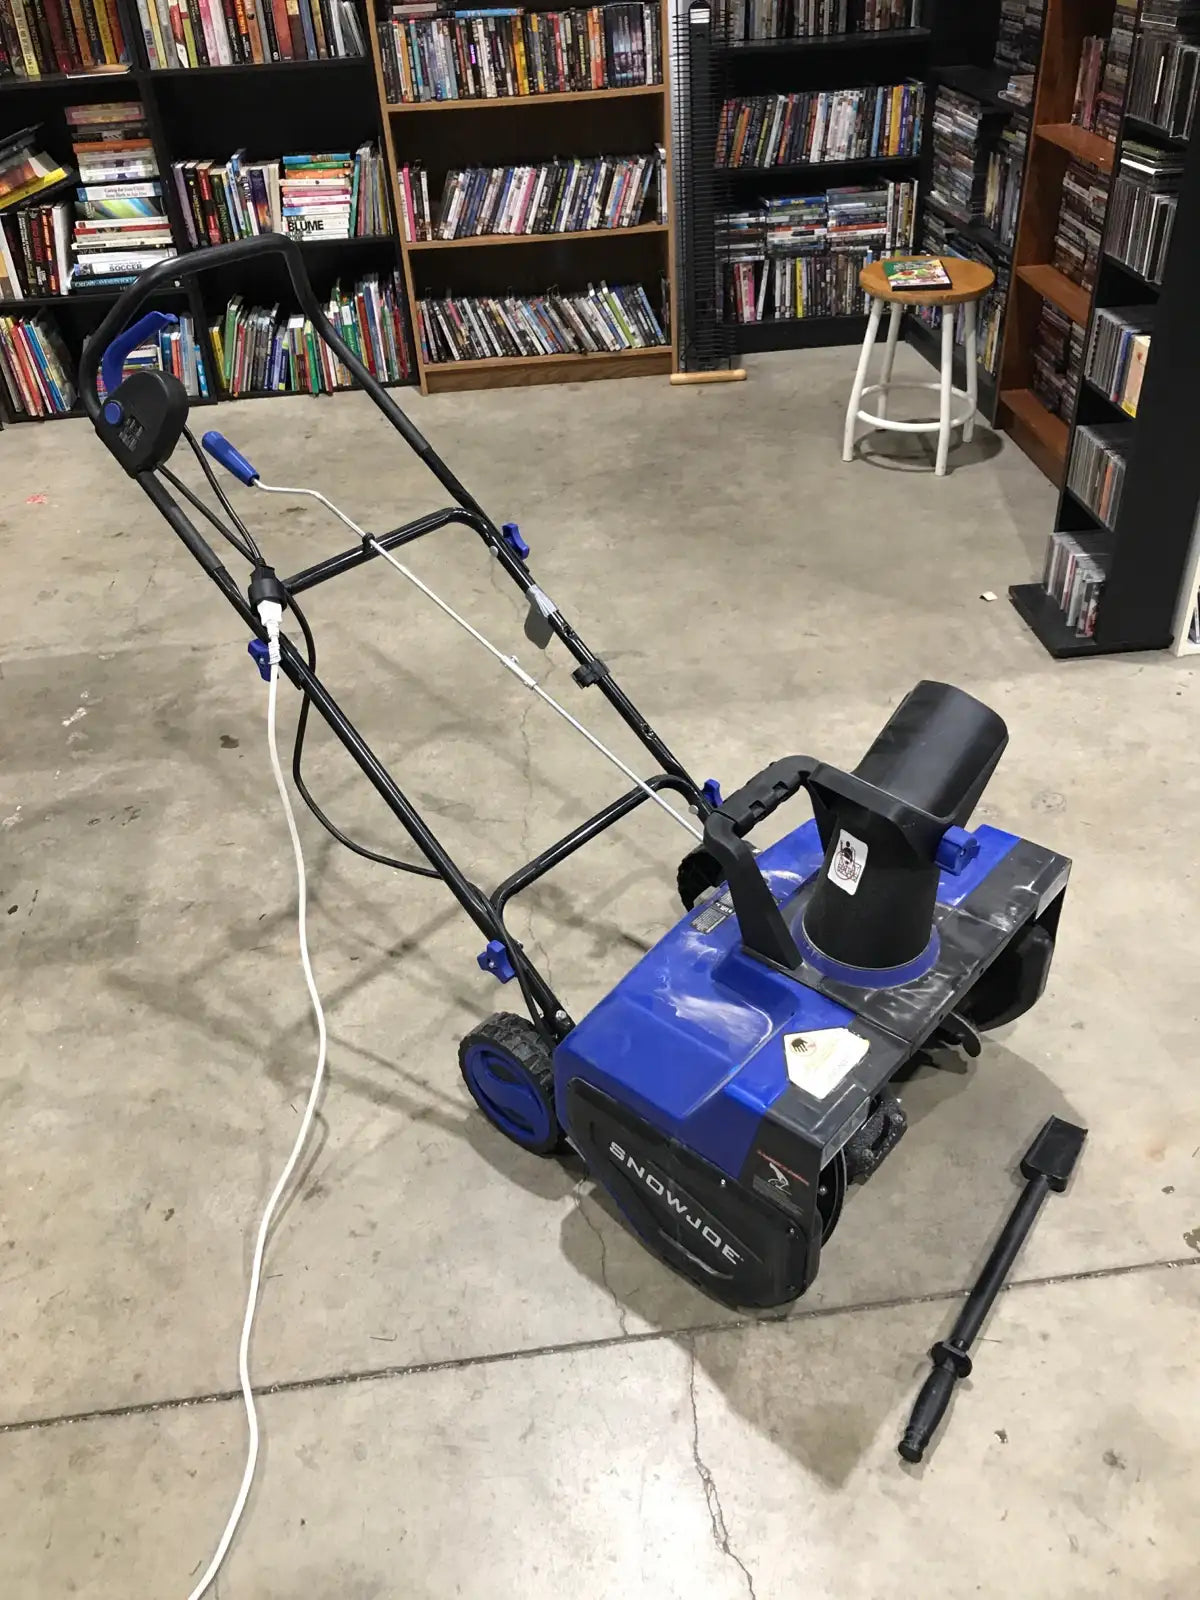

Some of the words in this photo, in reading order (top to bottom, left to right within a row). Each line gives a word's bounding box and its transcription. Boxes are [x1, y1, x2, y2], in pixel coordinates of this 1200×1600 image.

[288, 220, 324, 232] BLUME
[109, 264, 143, 272] SOCCER
[608, 1141, 742, 1265] SNOWJOE
